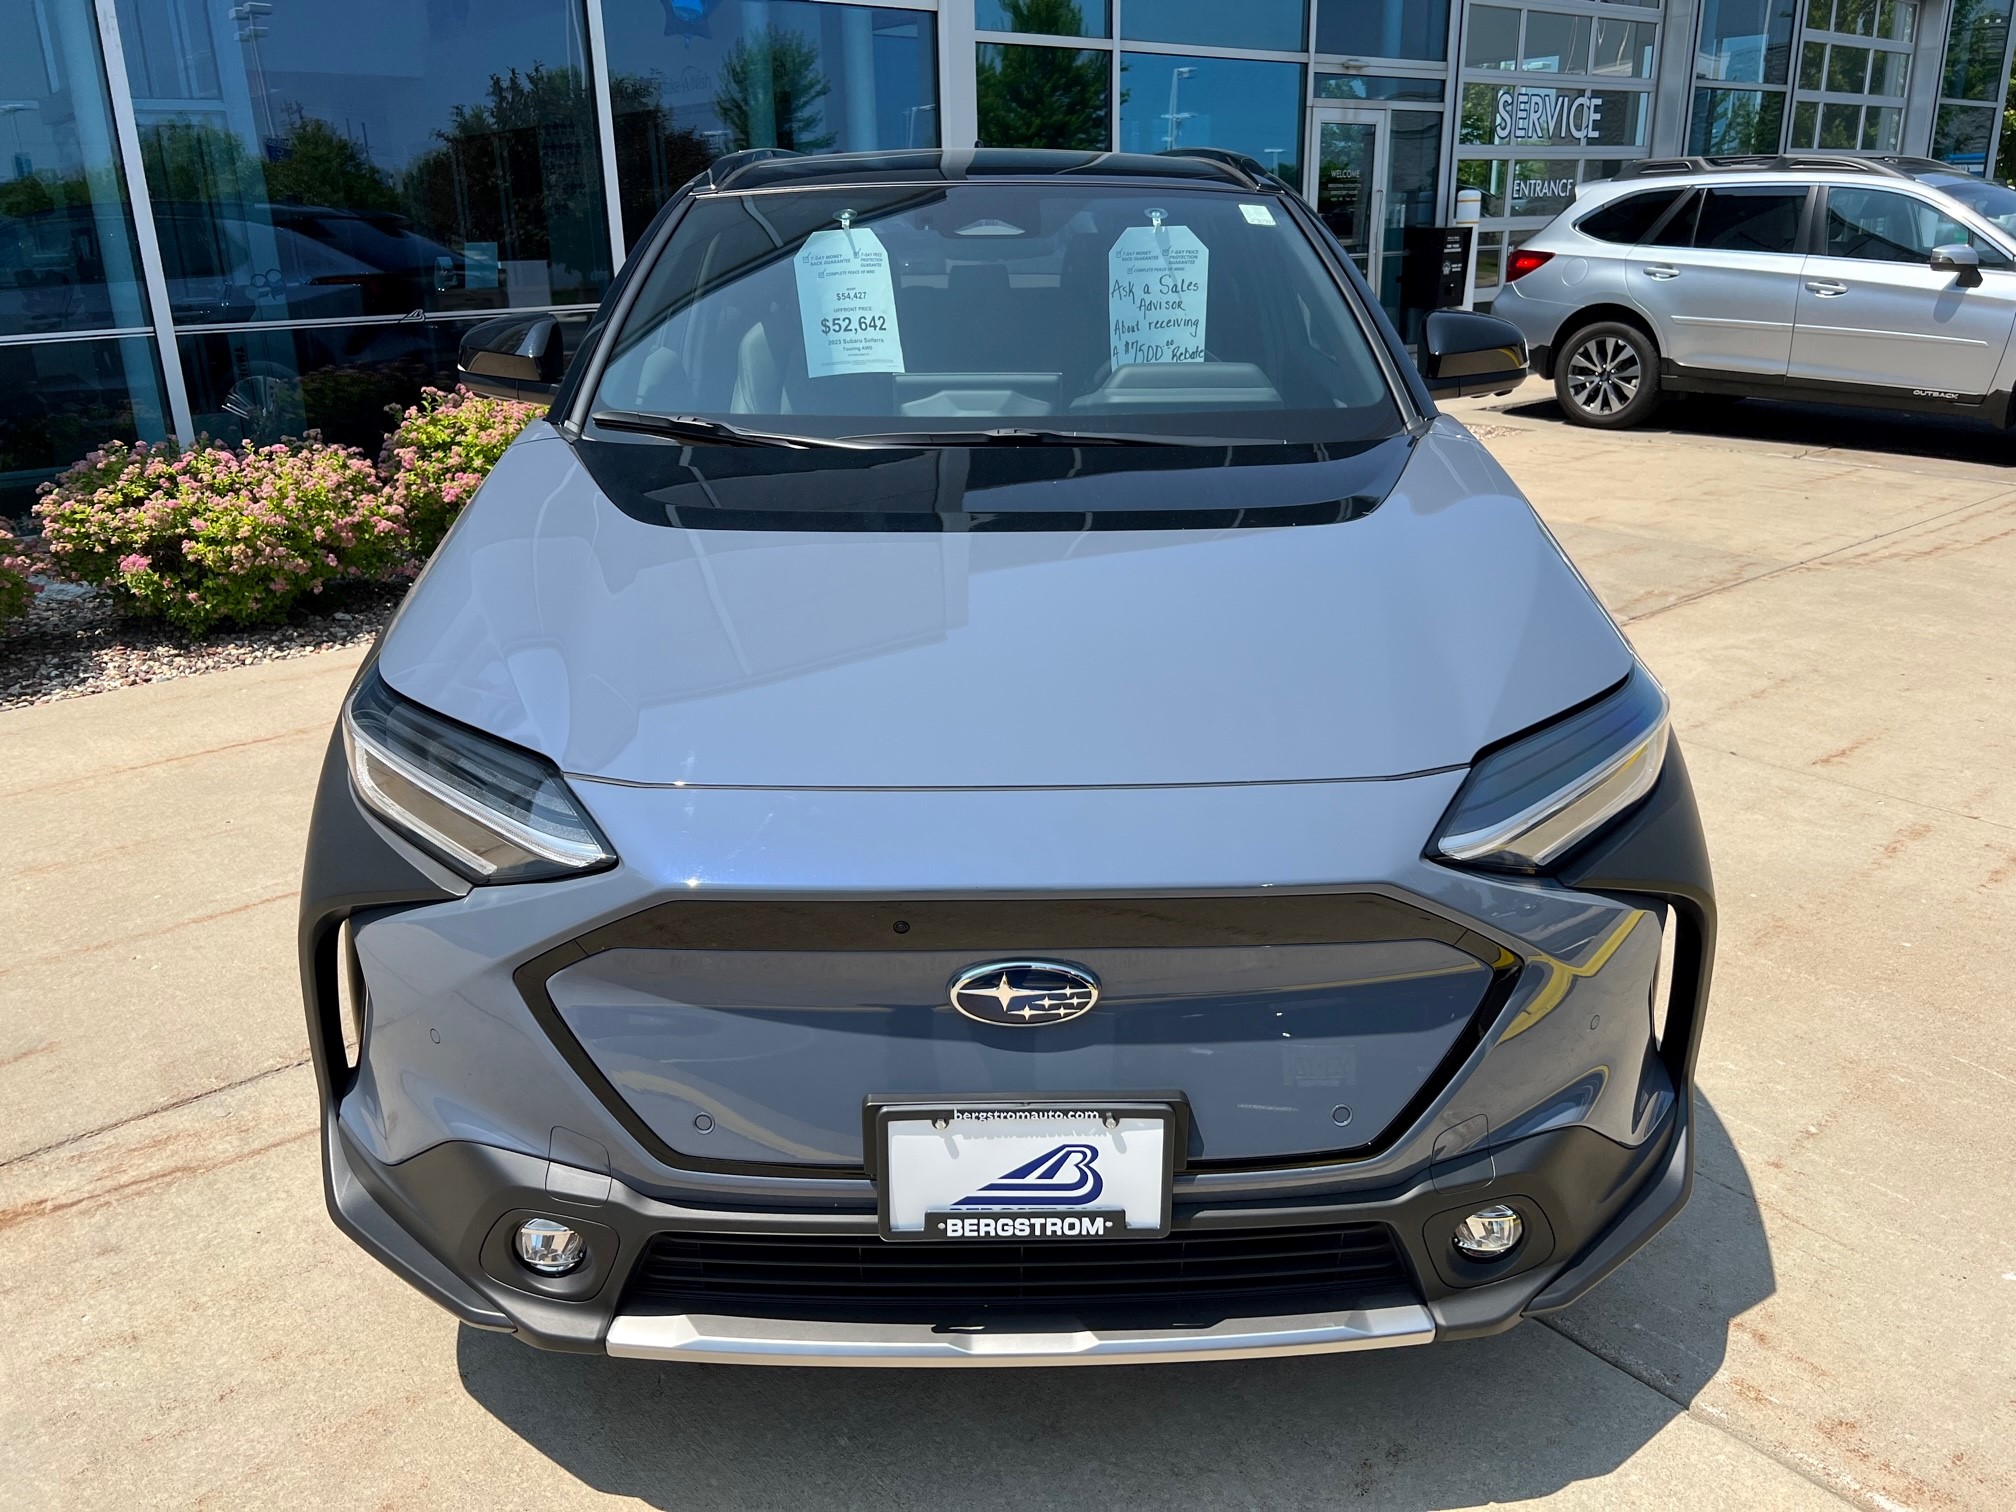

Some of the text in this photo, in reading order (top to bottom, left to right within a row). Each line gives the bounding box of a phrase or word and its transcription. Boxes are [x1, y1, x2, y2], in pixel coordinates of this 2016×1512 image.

[1496, 92, 1602, 139] SERVICE
[1330, 170, 1360, 178] WELCOME
[836, 291, 867, 301] $54,427
[1111, 274, 1199, 305] Ask a Sales
[820, 315, 887, 336] $52,642
[1114, 318, 1199, 341] About receiving
[1171, 345, 1204, 363] Rebate
[1913, 389, 1959, 399] OUTBACK
[954, 1107, 1099, 1122] bergstromauto.com
[946, 1217, 1104, 1237] BERGSTROM
